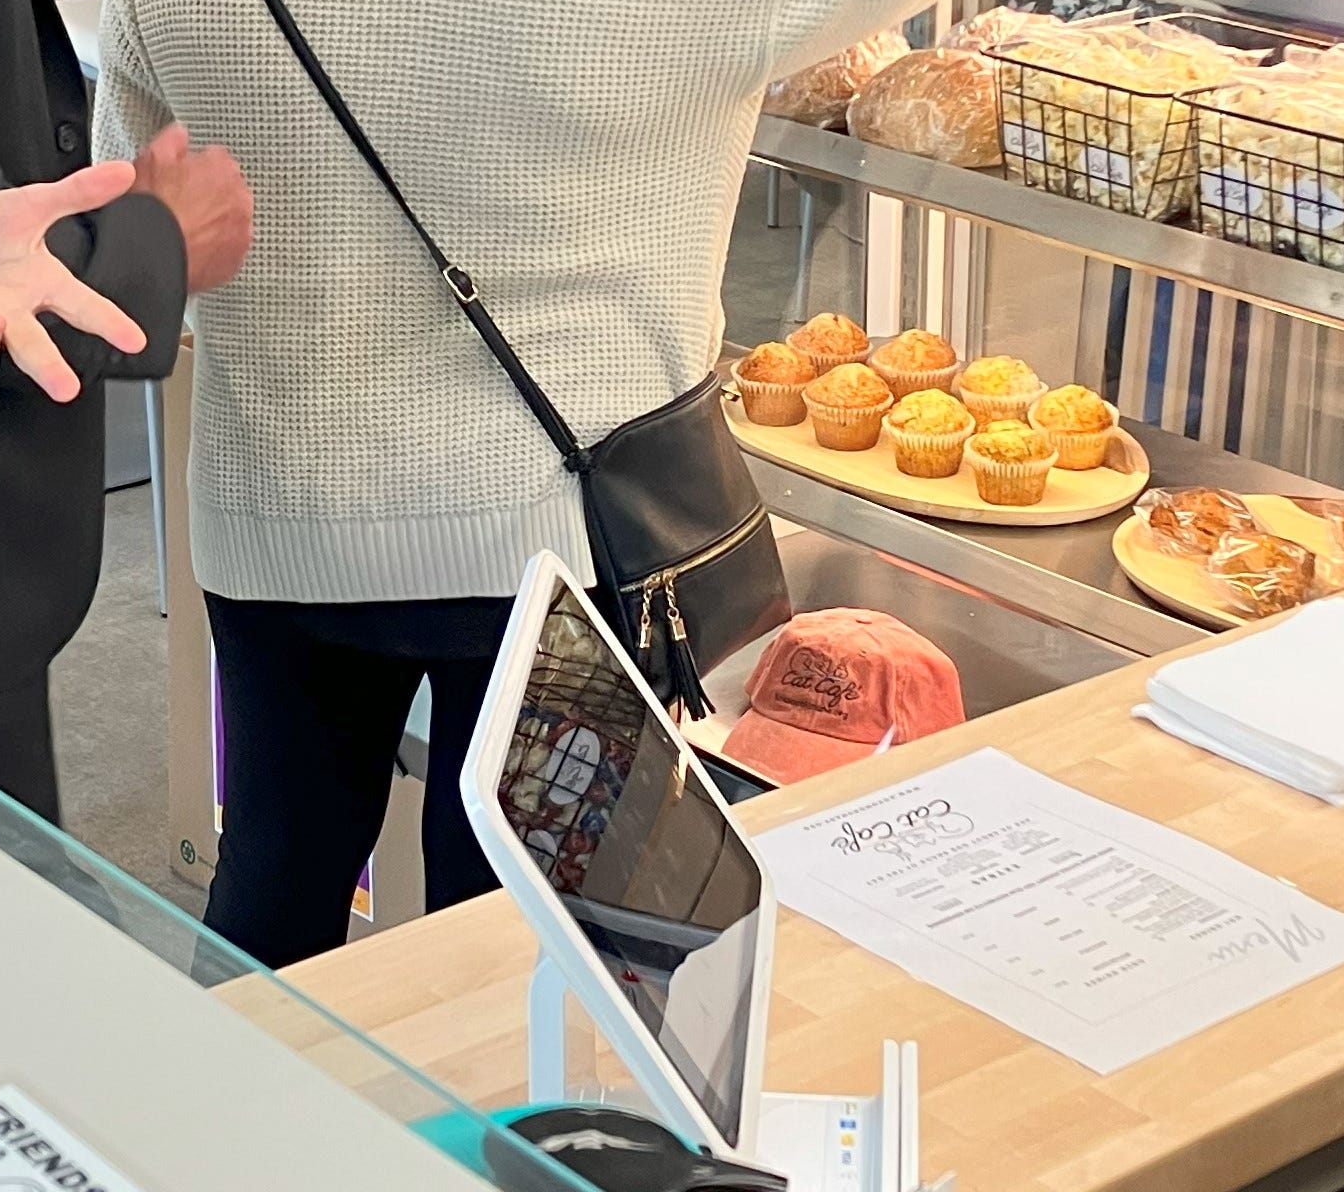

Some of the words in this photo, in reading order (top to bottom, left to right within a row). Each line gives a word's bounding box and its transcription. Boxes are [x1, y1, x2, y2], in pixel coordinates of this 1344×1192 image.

[780, 669, 813, 689] Cat
[895, 798, 952, 828] Cat
[1206, 911, 1327, 964] Menu
